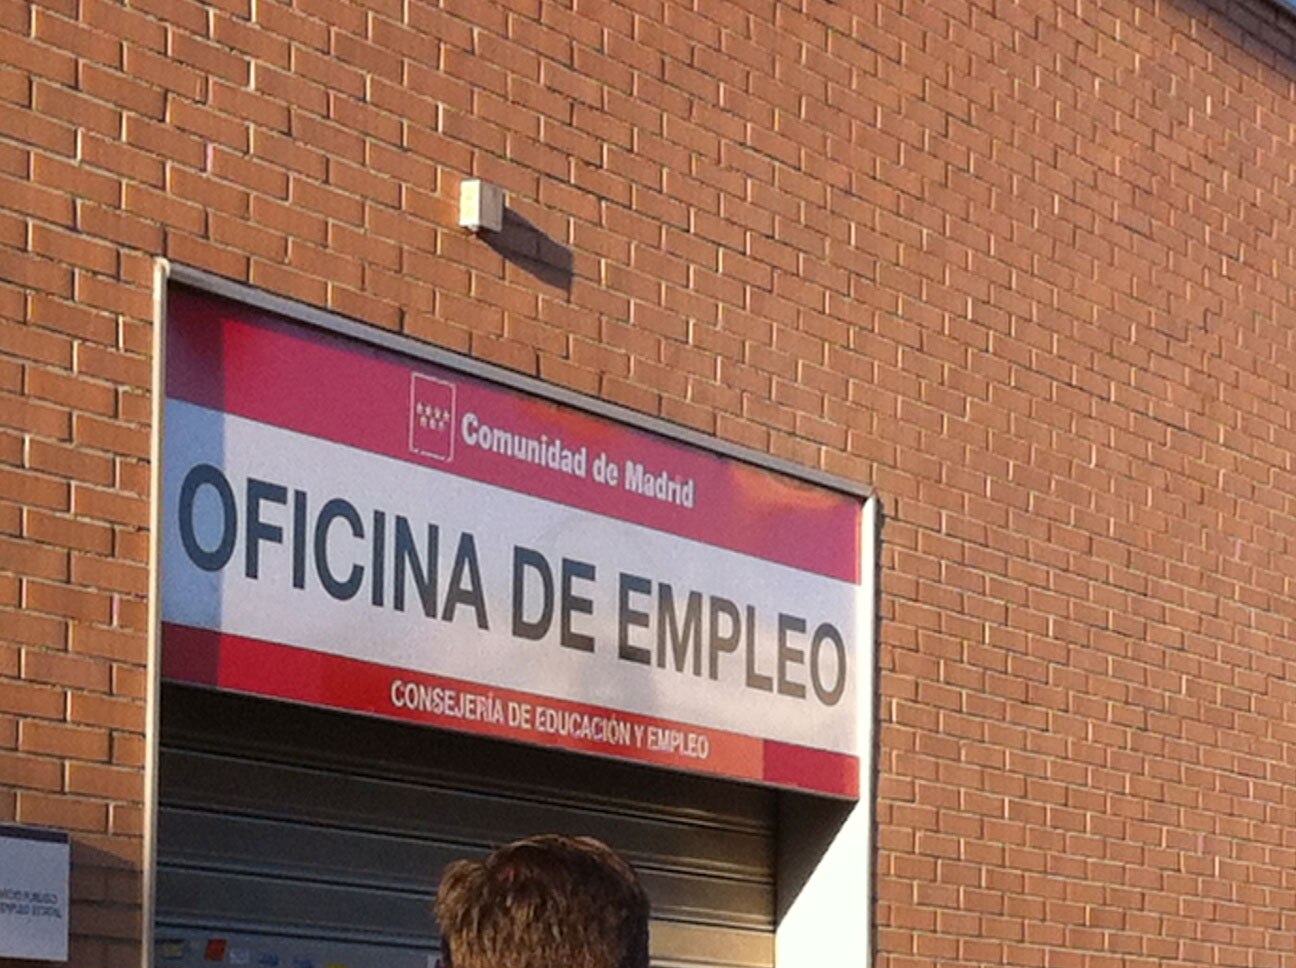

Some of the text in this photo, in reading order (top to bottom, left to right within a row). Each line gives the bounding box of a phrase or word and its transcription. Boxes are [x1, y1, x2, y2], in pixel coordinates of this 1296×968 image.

[462, 412, 695, 508] Comunidad de Madrid
[178, 463, 847, 706] OFICINA DE EMPLEO
[390, 680, 710, 760] CONSEJERÍA DE EDUCACIÓN Y EMPLEO
